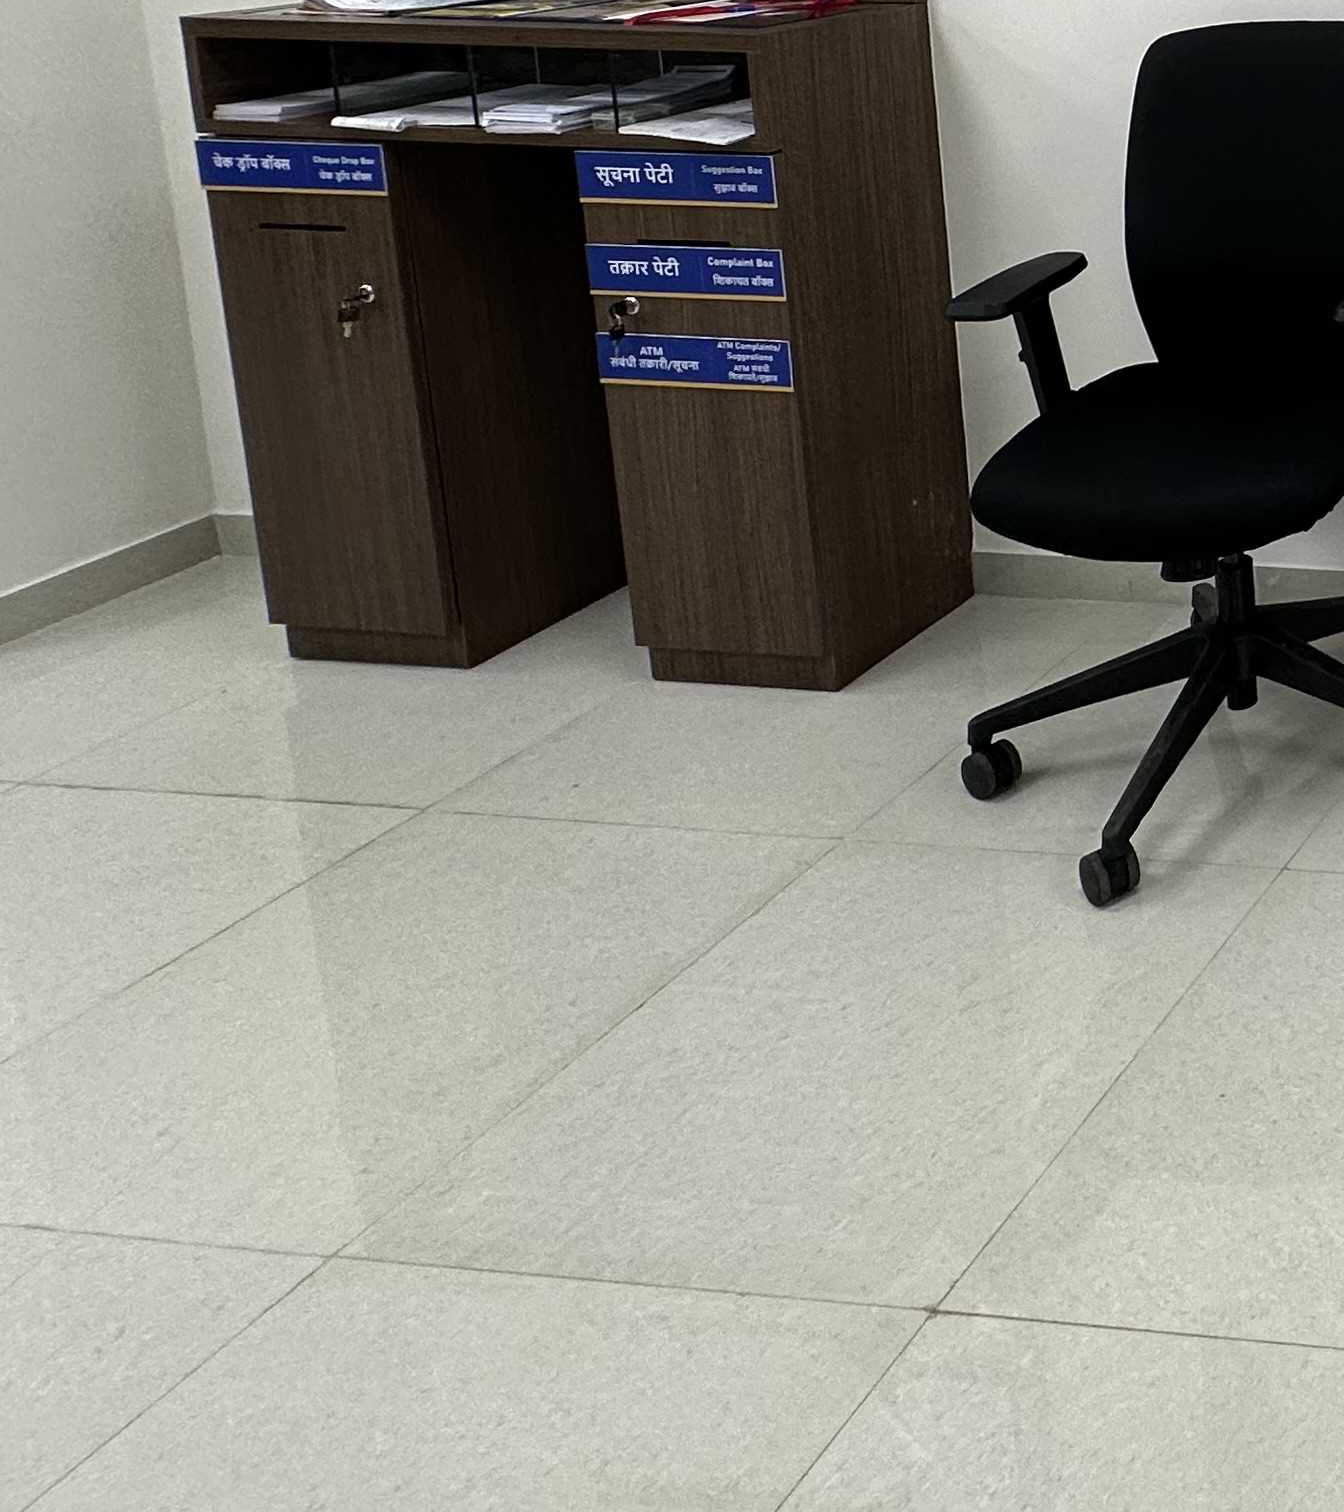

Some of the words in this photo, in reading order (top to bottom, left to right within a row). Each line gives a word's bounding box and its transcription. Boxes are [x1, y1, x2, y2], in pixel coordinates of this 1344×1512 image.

[212, 152, 233, 168] चेक
[594, 166, 639, 187] सूचना
[644, 162, 674, 184] पेटी
[701, 164, 745, 175] Suggestion
[748, 166, 762, 175] Box
[608, 259, 648, 276] तक्रार
[651, 256, 680, 276] पेटी
[707, 256, 754, 268] Complaint
[756, 257, 773, 268] Box
[717, 341, 732, 349] ATM
[640, 346, 663, 356] ATM
[734, 364, 749, 373] ATM
